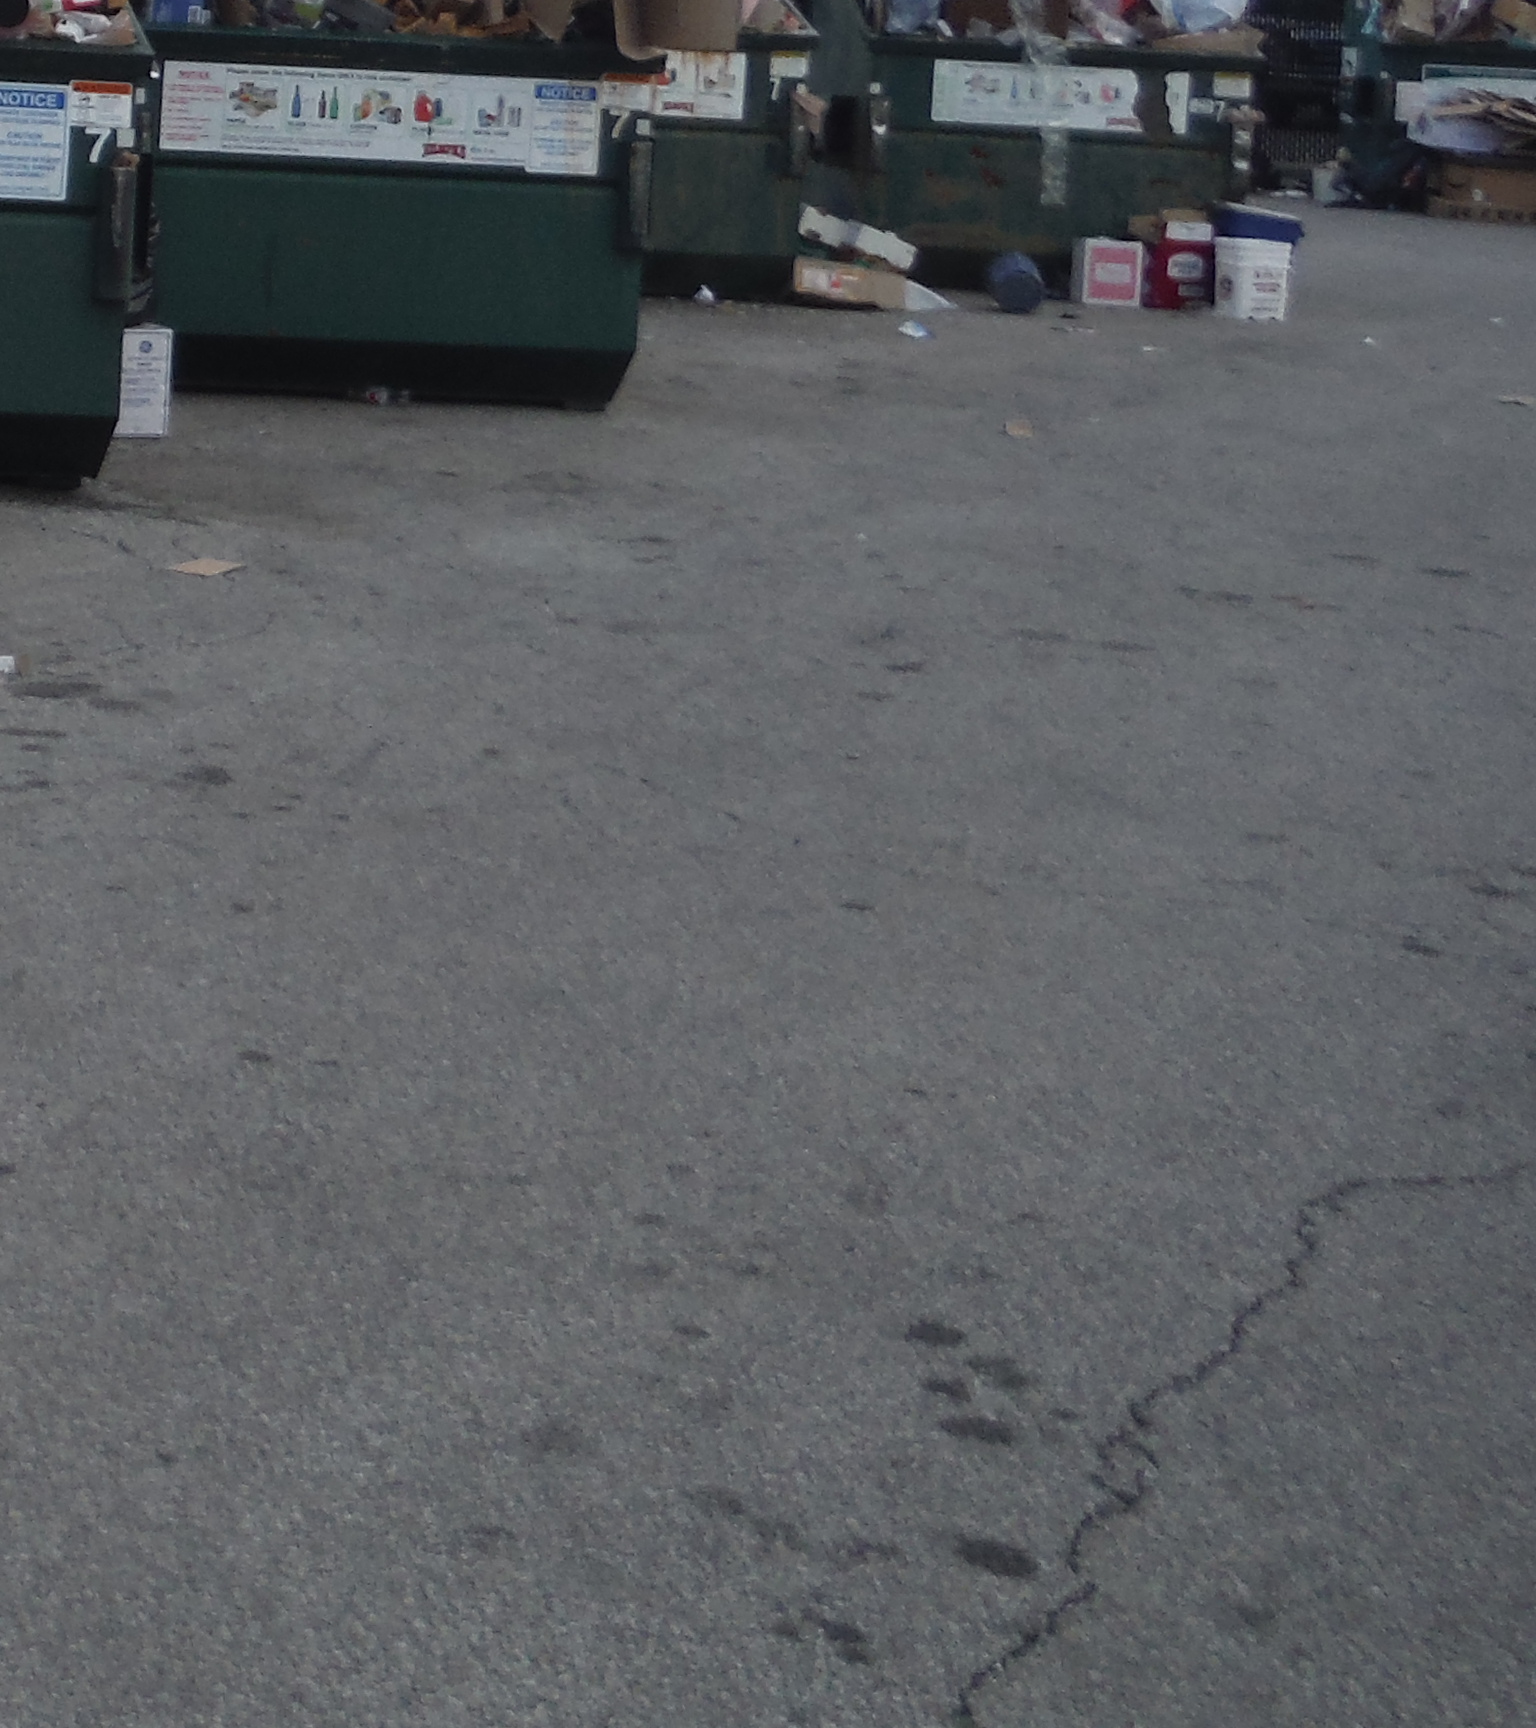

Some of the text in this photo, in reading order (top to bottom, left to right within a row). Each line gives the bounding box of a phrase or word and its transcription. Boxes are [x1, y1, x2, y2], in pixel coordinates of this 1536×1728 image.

[540, 85, 591, 101] NOTICE
[609, 108, 631, 139] 7
[85, 127, 112, 163] 7
